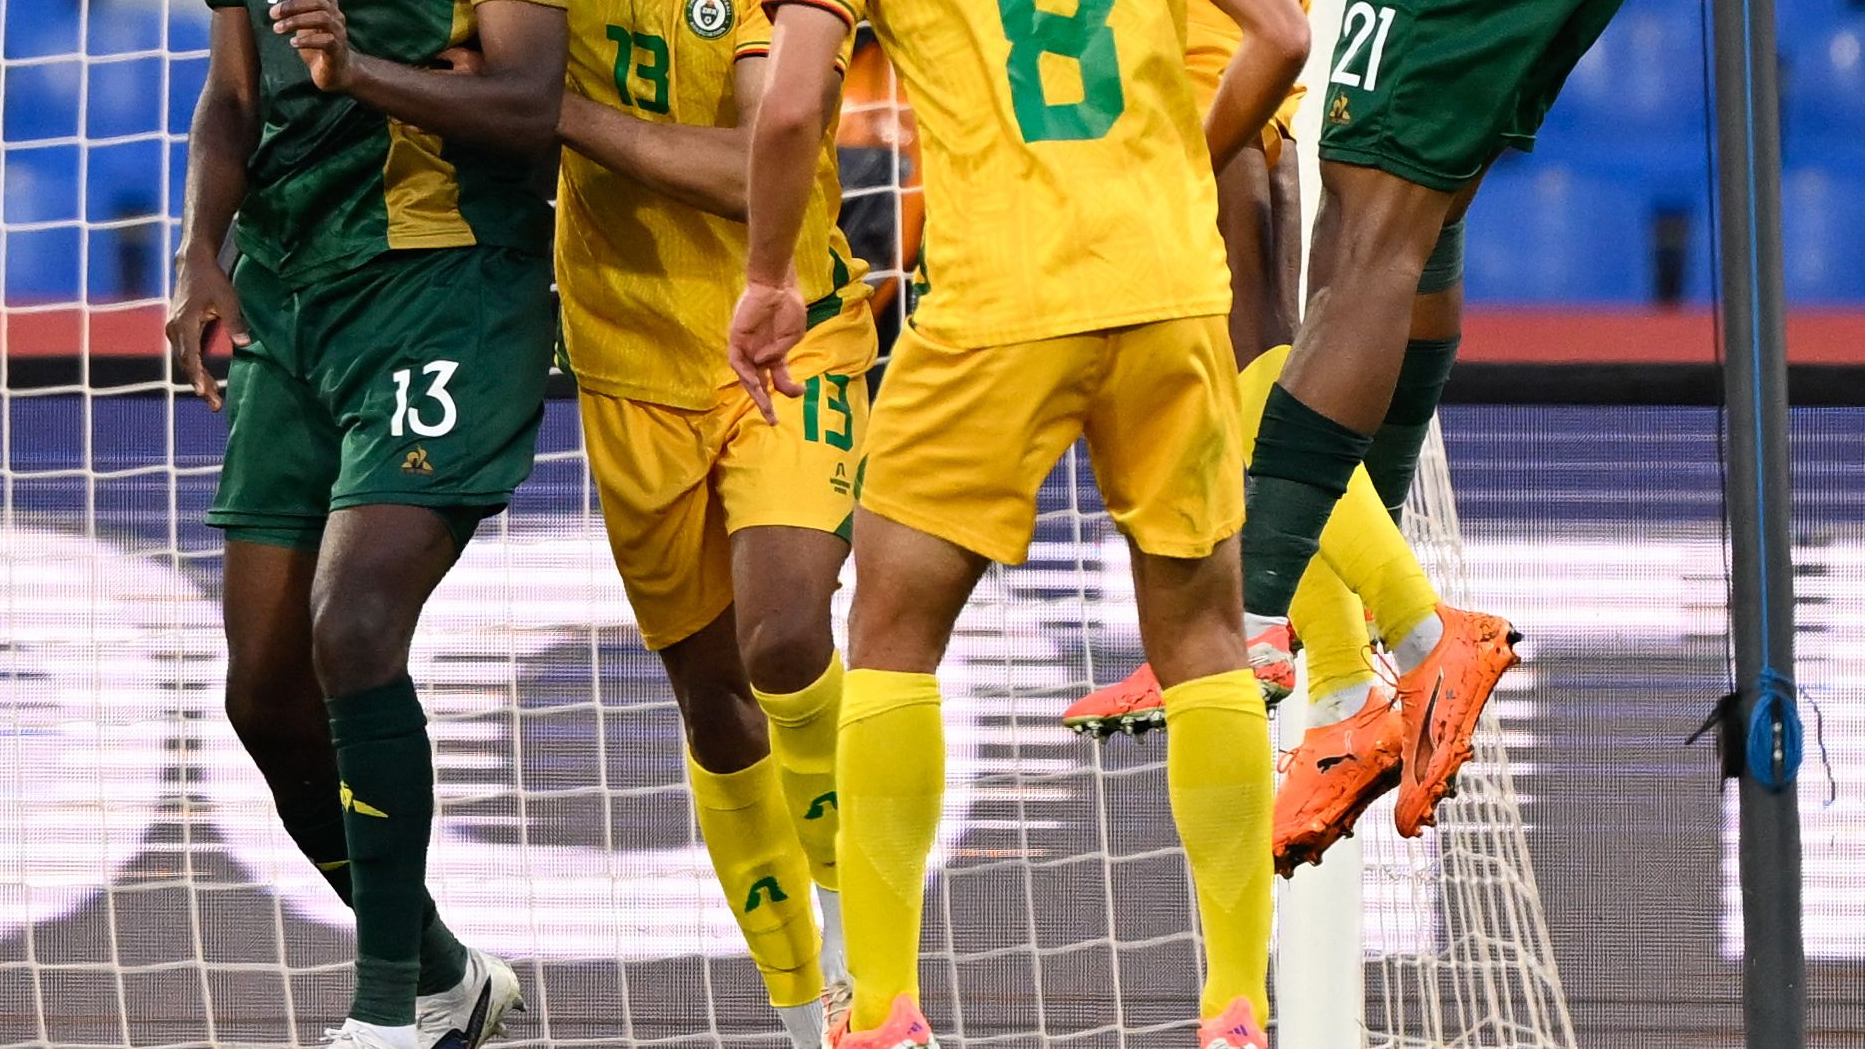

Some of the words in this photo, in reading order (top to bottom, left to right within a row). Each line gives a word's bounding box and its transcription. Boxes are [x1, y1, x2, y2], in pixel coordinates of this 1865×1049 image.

[606, 24, 670, 115] 13
[1330, 1, 1396, 91] 21
[391, 360, 460, 437] 13
[803, 372, 854, 452] 13
